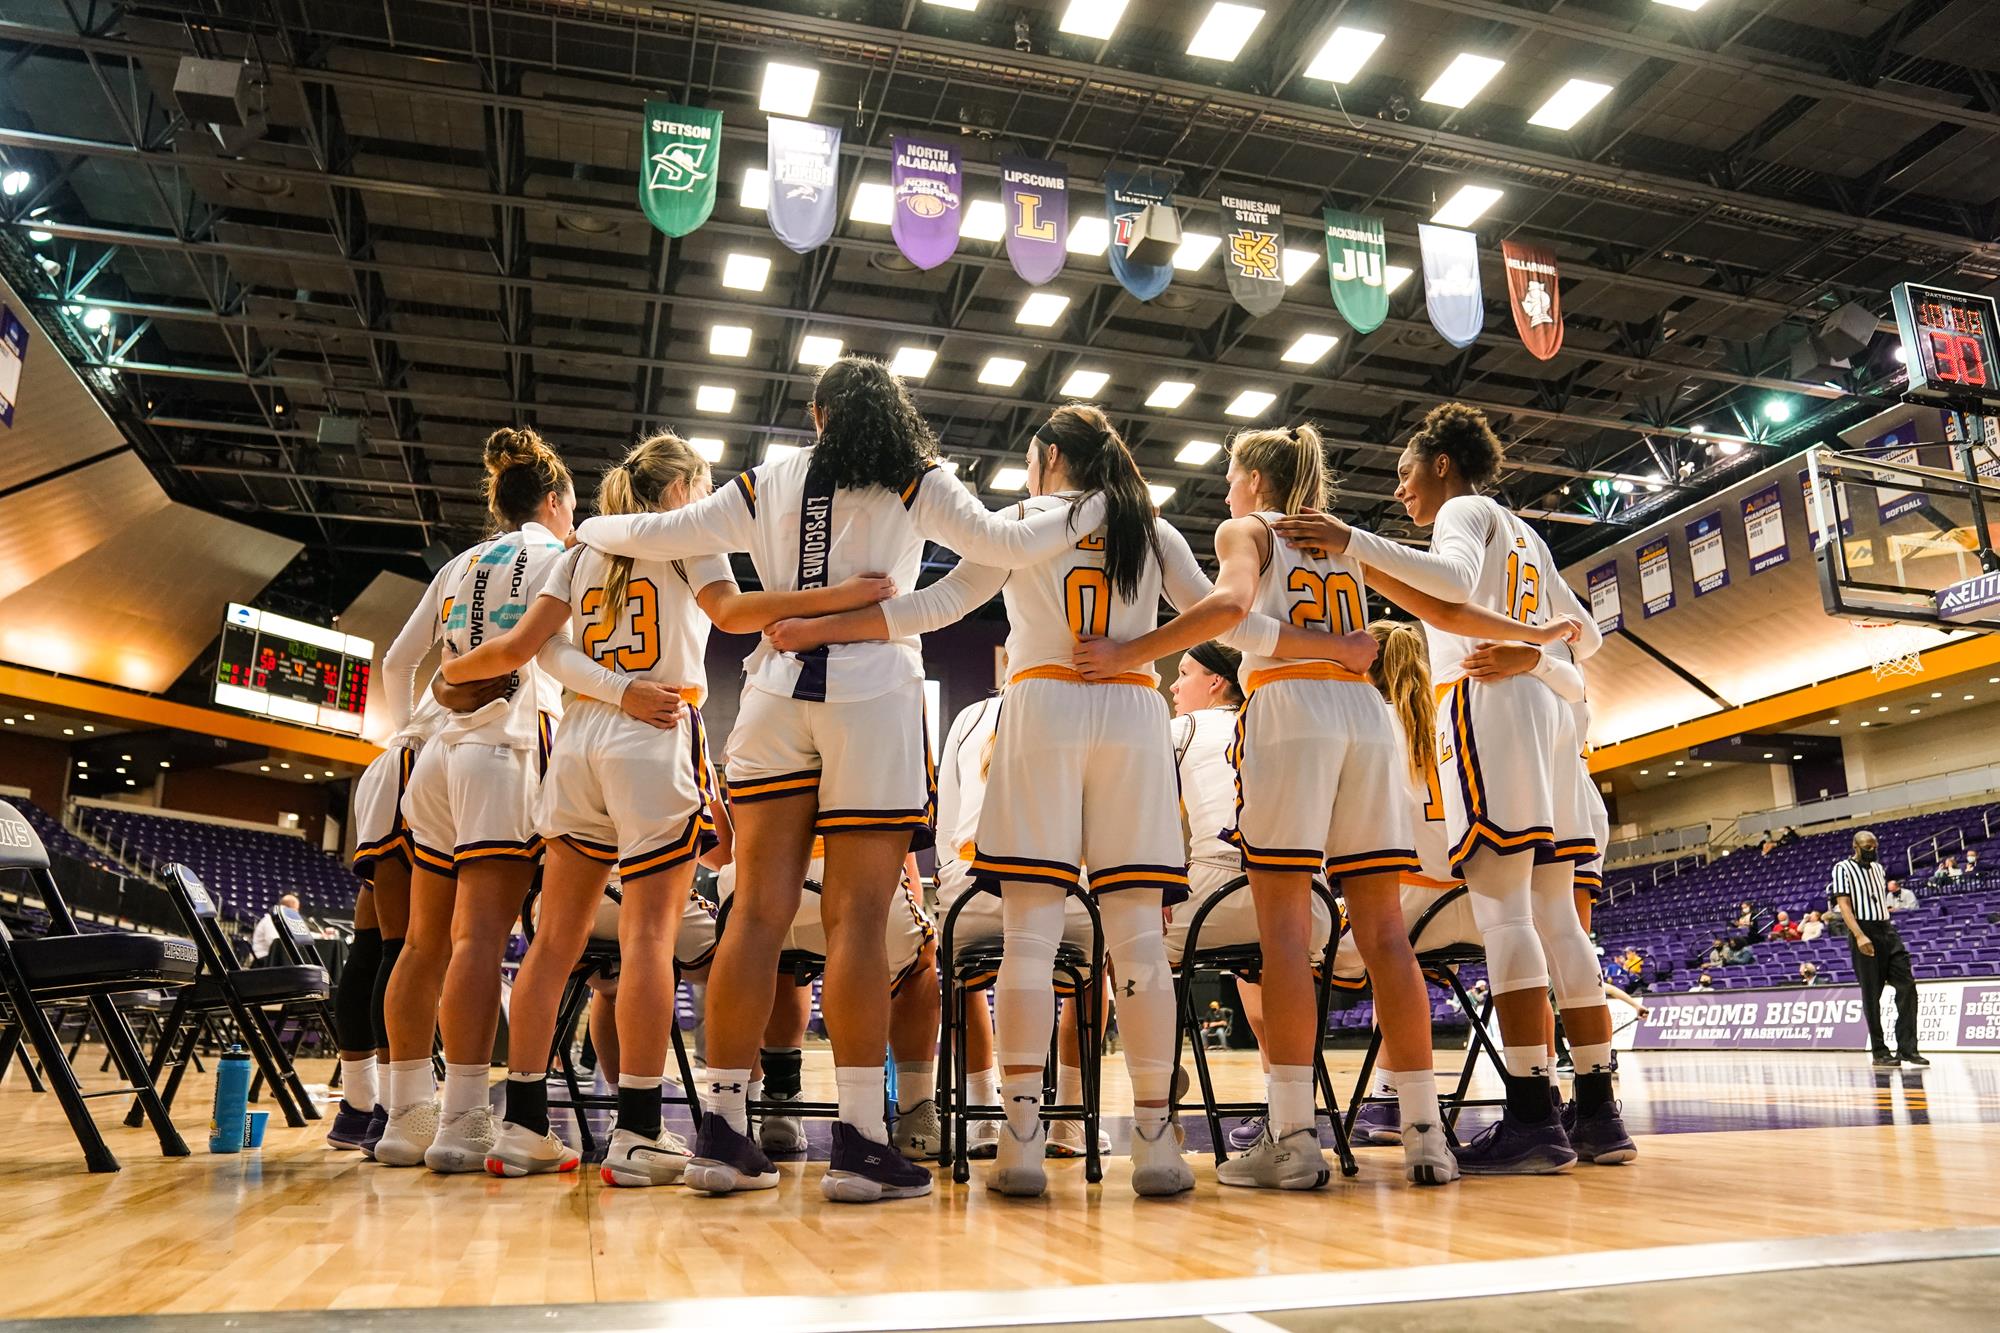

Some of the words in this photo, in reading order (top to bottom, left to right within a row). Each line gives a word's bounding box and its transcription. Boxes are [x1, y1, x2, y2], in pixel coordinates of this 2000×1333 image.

[652, 119, 711, 140] STETSON
[908, 144, 949, 161] NORTH
[896, 154, 957, 175] ALABAMA
[1004, 169, 1065, 190] LIPSCOMB
[1221, 195, 1280, 215] KENNESAW
[1014, 191, 1057, 243] L
[1235, 209, 1269, 225] STATE
[1327, 225, 1385, 245] JACKSONVILLE
[1332, 248, 1382, 287] JU
[1924, 291, 1968, 303] DAKTRONICS
[1929, 331, 1986, 385] 30
[1744, 501, 1780, 523] CHAMPIONS
[1885, 498, 1922, 519] SOFTBALL
[803, 496, 830, 579] LIPSCOMB
[1755, 554, 1784, 571] SOFTBALL
[1505, 550, 1540, 626] 12
[1287, 566, 1366, 636] 20
[581, 577, 661, 674] 23
[260, 654, 277, 671] 58
[164, 942, 198, 963] LIPSCOMB
[1644, 1002, 1758, 1028] LIPSCOMB
[1763, 999, 1863, 1025] BISONS
[1922, 1018, 1942, 1029] ON
[1659, 1028, 1693, 1040] ALLEN
[1694, 1028, 1731, 1040] ARENA
[1742, 1027, 1812, 1040] NASHVILLE,
[1815, 1026, 1834, 1039] TN
